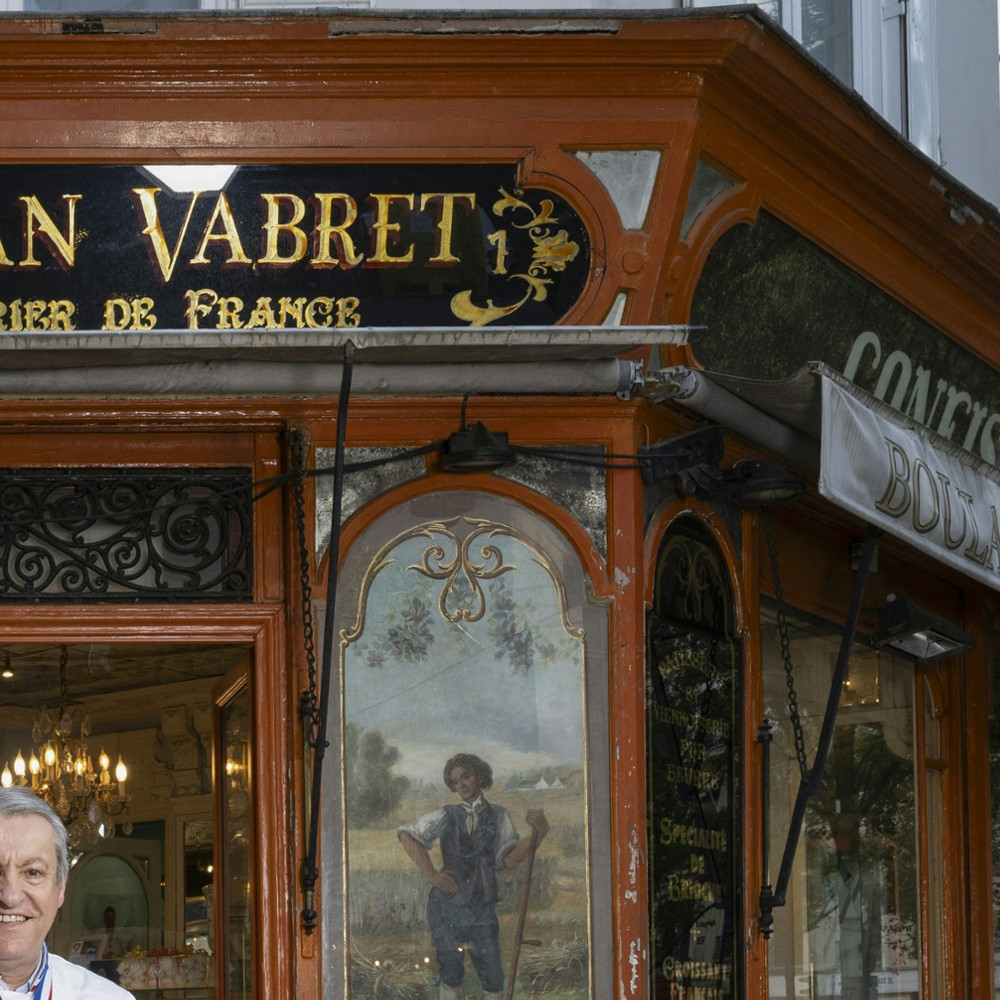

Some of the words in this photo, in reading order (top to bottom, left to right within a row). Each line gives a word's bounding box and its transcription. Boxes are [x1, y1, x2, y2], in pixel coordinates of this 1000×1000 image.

[132, 186, 477, 284] VABRET
[101, 297, 157, 331] DE
[185, 288, 360, 329] FRANCE
[662, 955, 728, 981] CROISSANT
